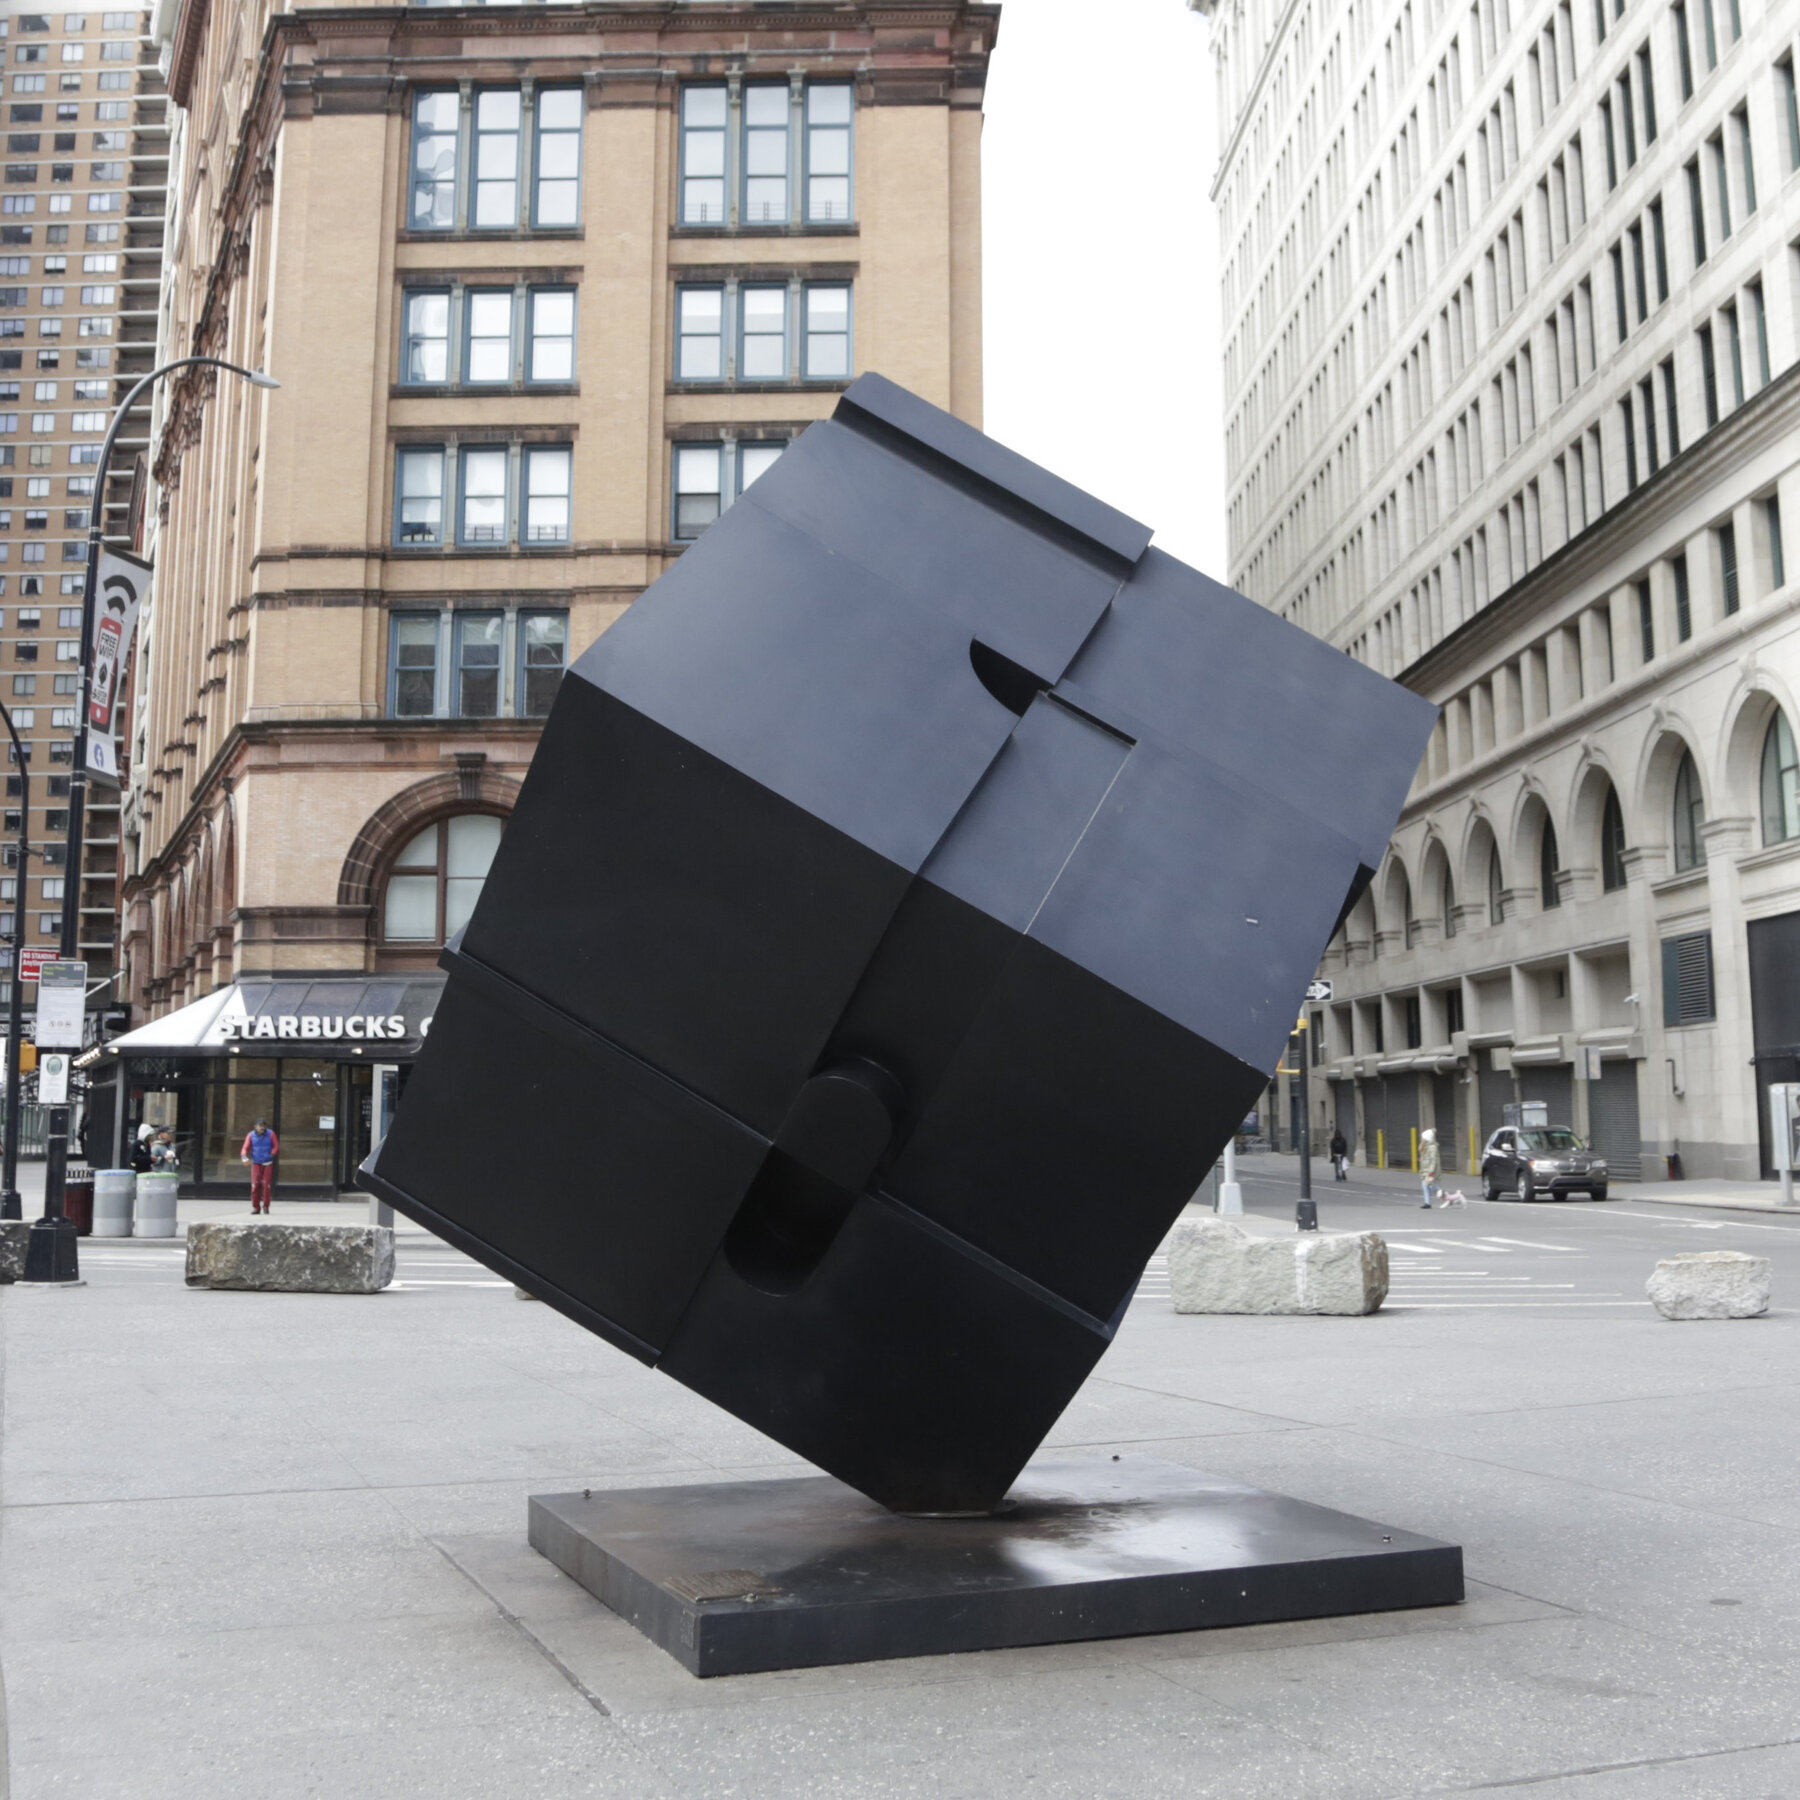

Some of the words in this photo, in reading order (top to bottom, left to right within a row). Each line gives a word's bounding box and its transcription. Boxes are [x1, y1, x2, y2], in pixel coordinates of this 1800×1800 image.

[101, 631, 117, 648] FREE
[31, 952, 57, 960] STANDING
[218, 1015, 405, 1039] STARBUCKS
